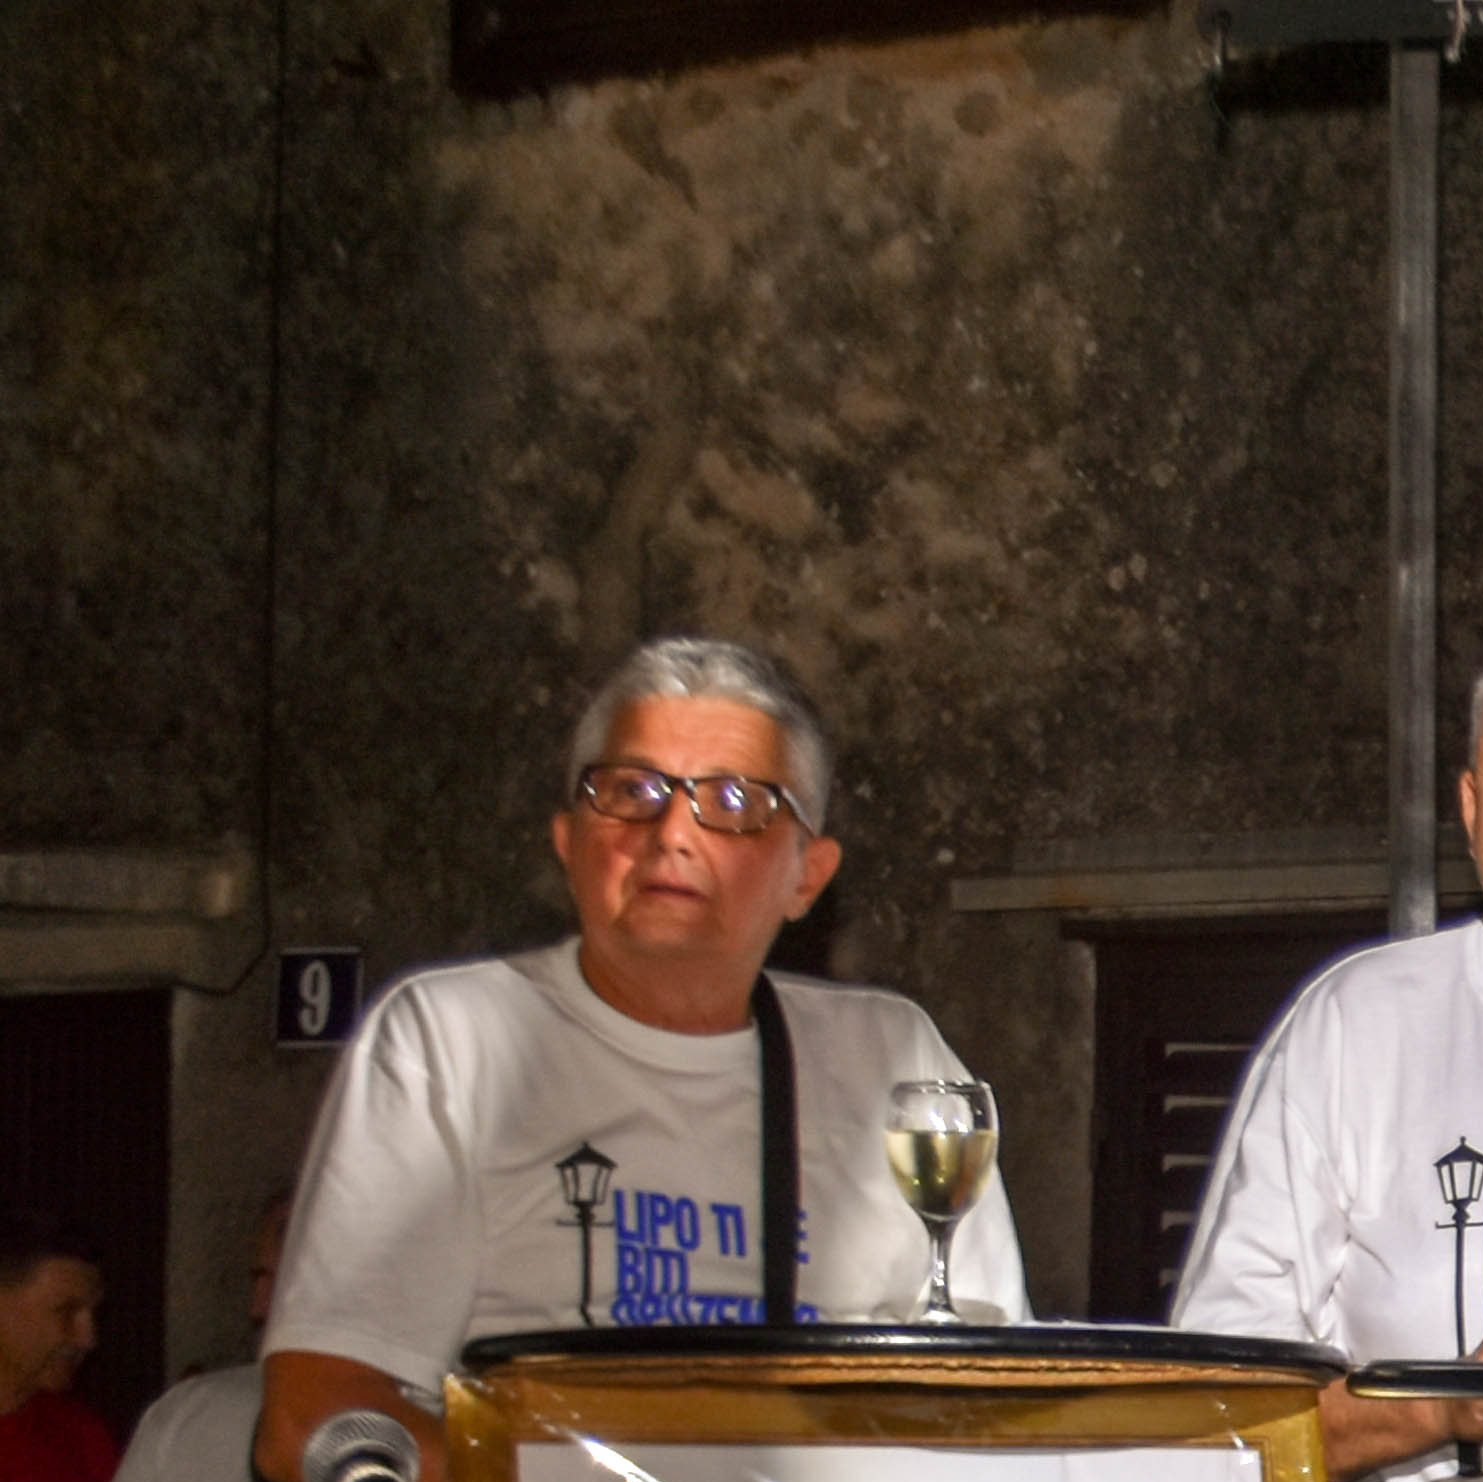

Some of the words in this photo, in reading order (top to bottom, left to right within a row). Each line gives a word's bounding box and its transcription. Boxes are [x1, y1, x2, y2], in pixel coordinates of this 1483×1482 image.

[299, 959, 331, 1037] 9
[613, 1189, 700, 1251] LIPO
[710, 1202, 747, 1257] TI
[617, 1243, 690, 1297] BITI
